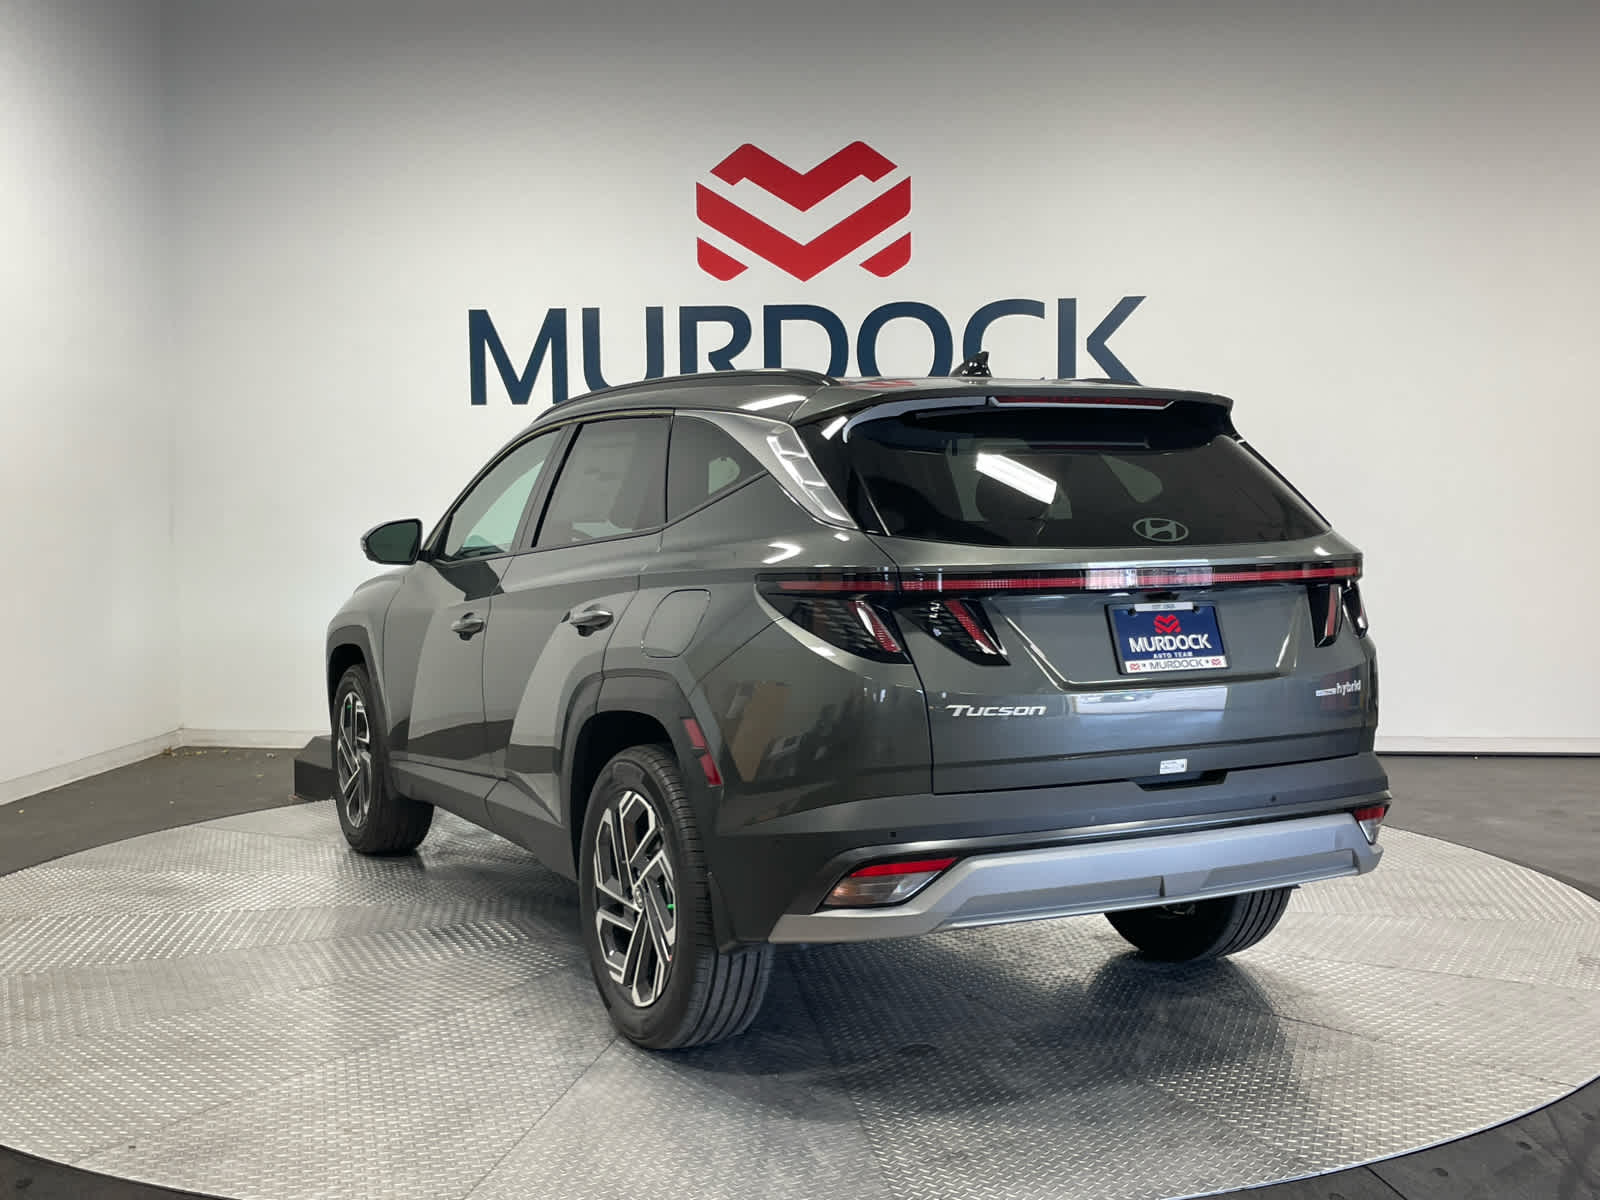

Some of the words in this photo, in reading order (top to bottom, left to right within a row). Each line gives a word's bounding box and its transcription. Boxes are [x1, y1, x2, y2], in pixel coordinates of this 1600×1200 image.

[468, 296, 1147, 406] MURDOCK
[1129, 633, 1212, 653] MURDOCK
[1150, 658, 1204, 669] MURDOCK
